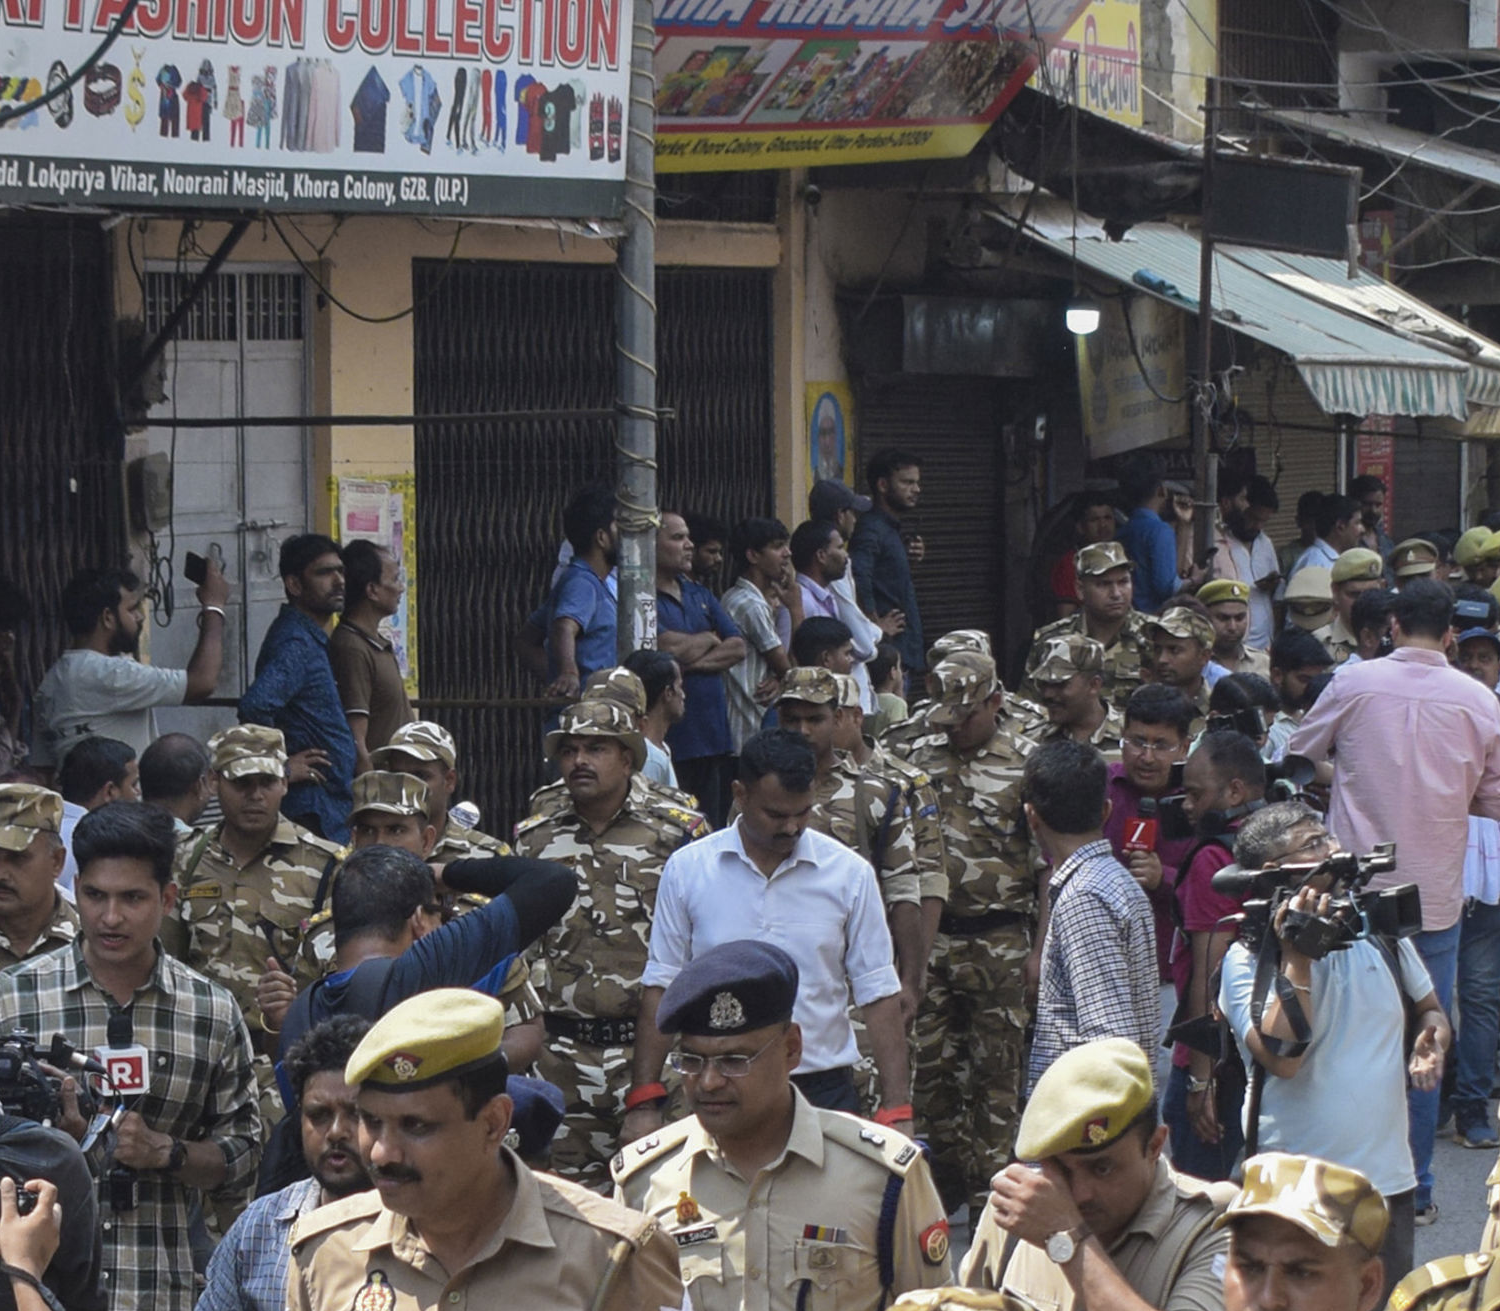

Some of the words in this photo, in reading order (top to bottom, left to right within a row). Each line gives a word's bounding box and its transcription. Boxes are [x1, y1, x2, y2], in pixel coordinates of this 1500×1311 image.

[28, 162, 105, 201] Lokpriya
[110, 165, 159, 195] Vihar,
[163, 168, 228, 195] Noorani
[232, 171, 289, 202] Masjid,
[293, 174, 340, 199] Khora
[343, 176, 397, 206] Colony,
[400, 178, 430, 201] GZB.
[434, 176, 469, 206] (U.P.)
